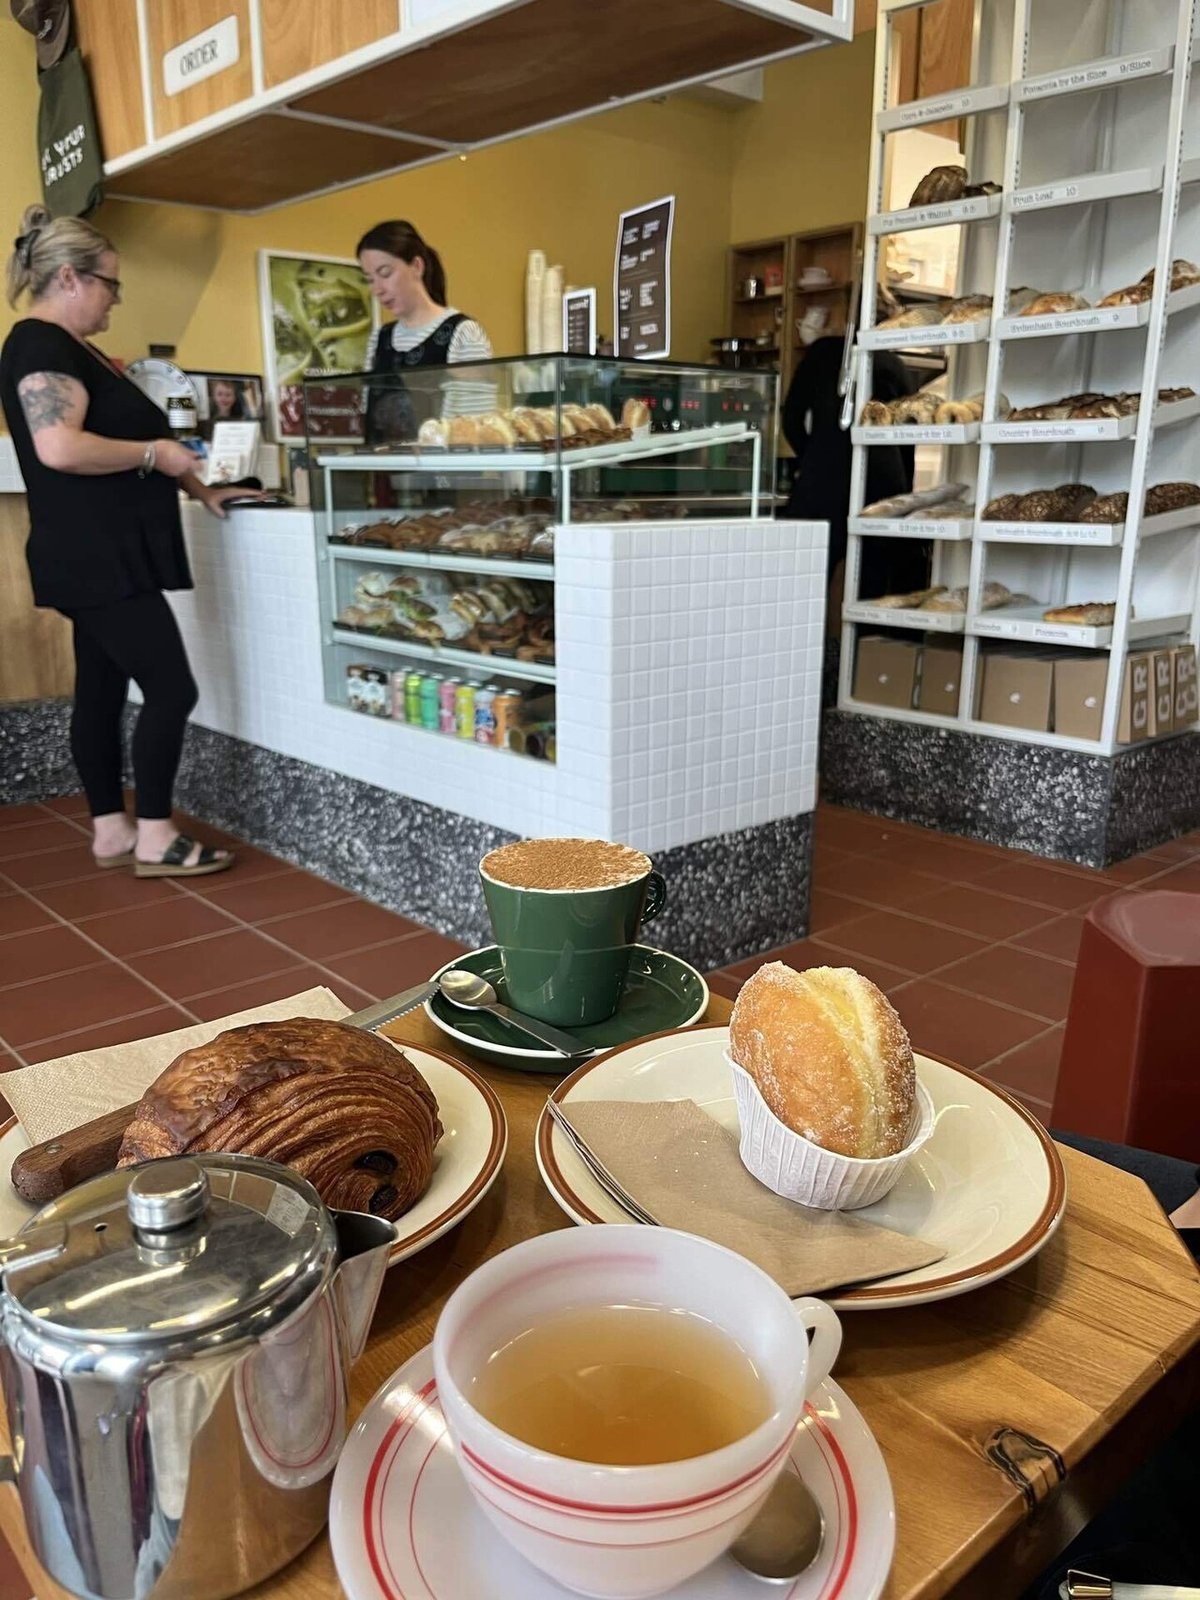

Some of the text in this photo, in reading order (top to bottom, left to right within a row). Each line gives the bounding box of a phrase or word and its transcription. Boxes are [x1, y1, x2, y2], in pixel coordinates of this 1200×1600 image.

[180, 39, 218, 76] ORDER
[1071, 74, 1085, 85] the
[1086, 70, 1108, 82] Slice
[1012, 195, 1034, 207] Fruit
[1066, 185, 1077, 197] 10
